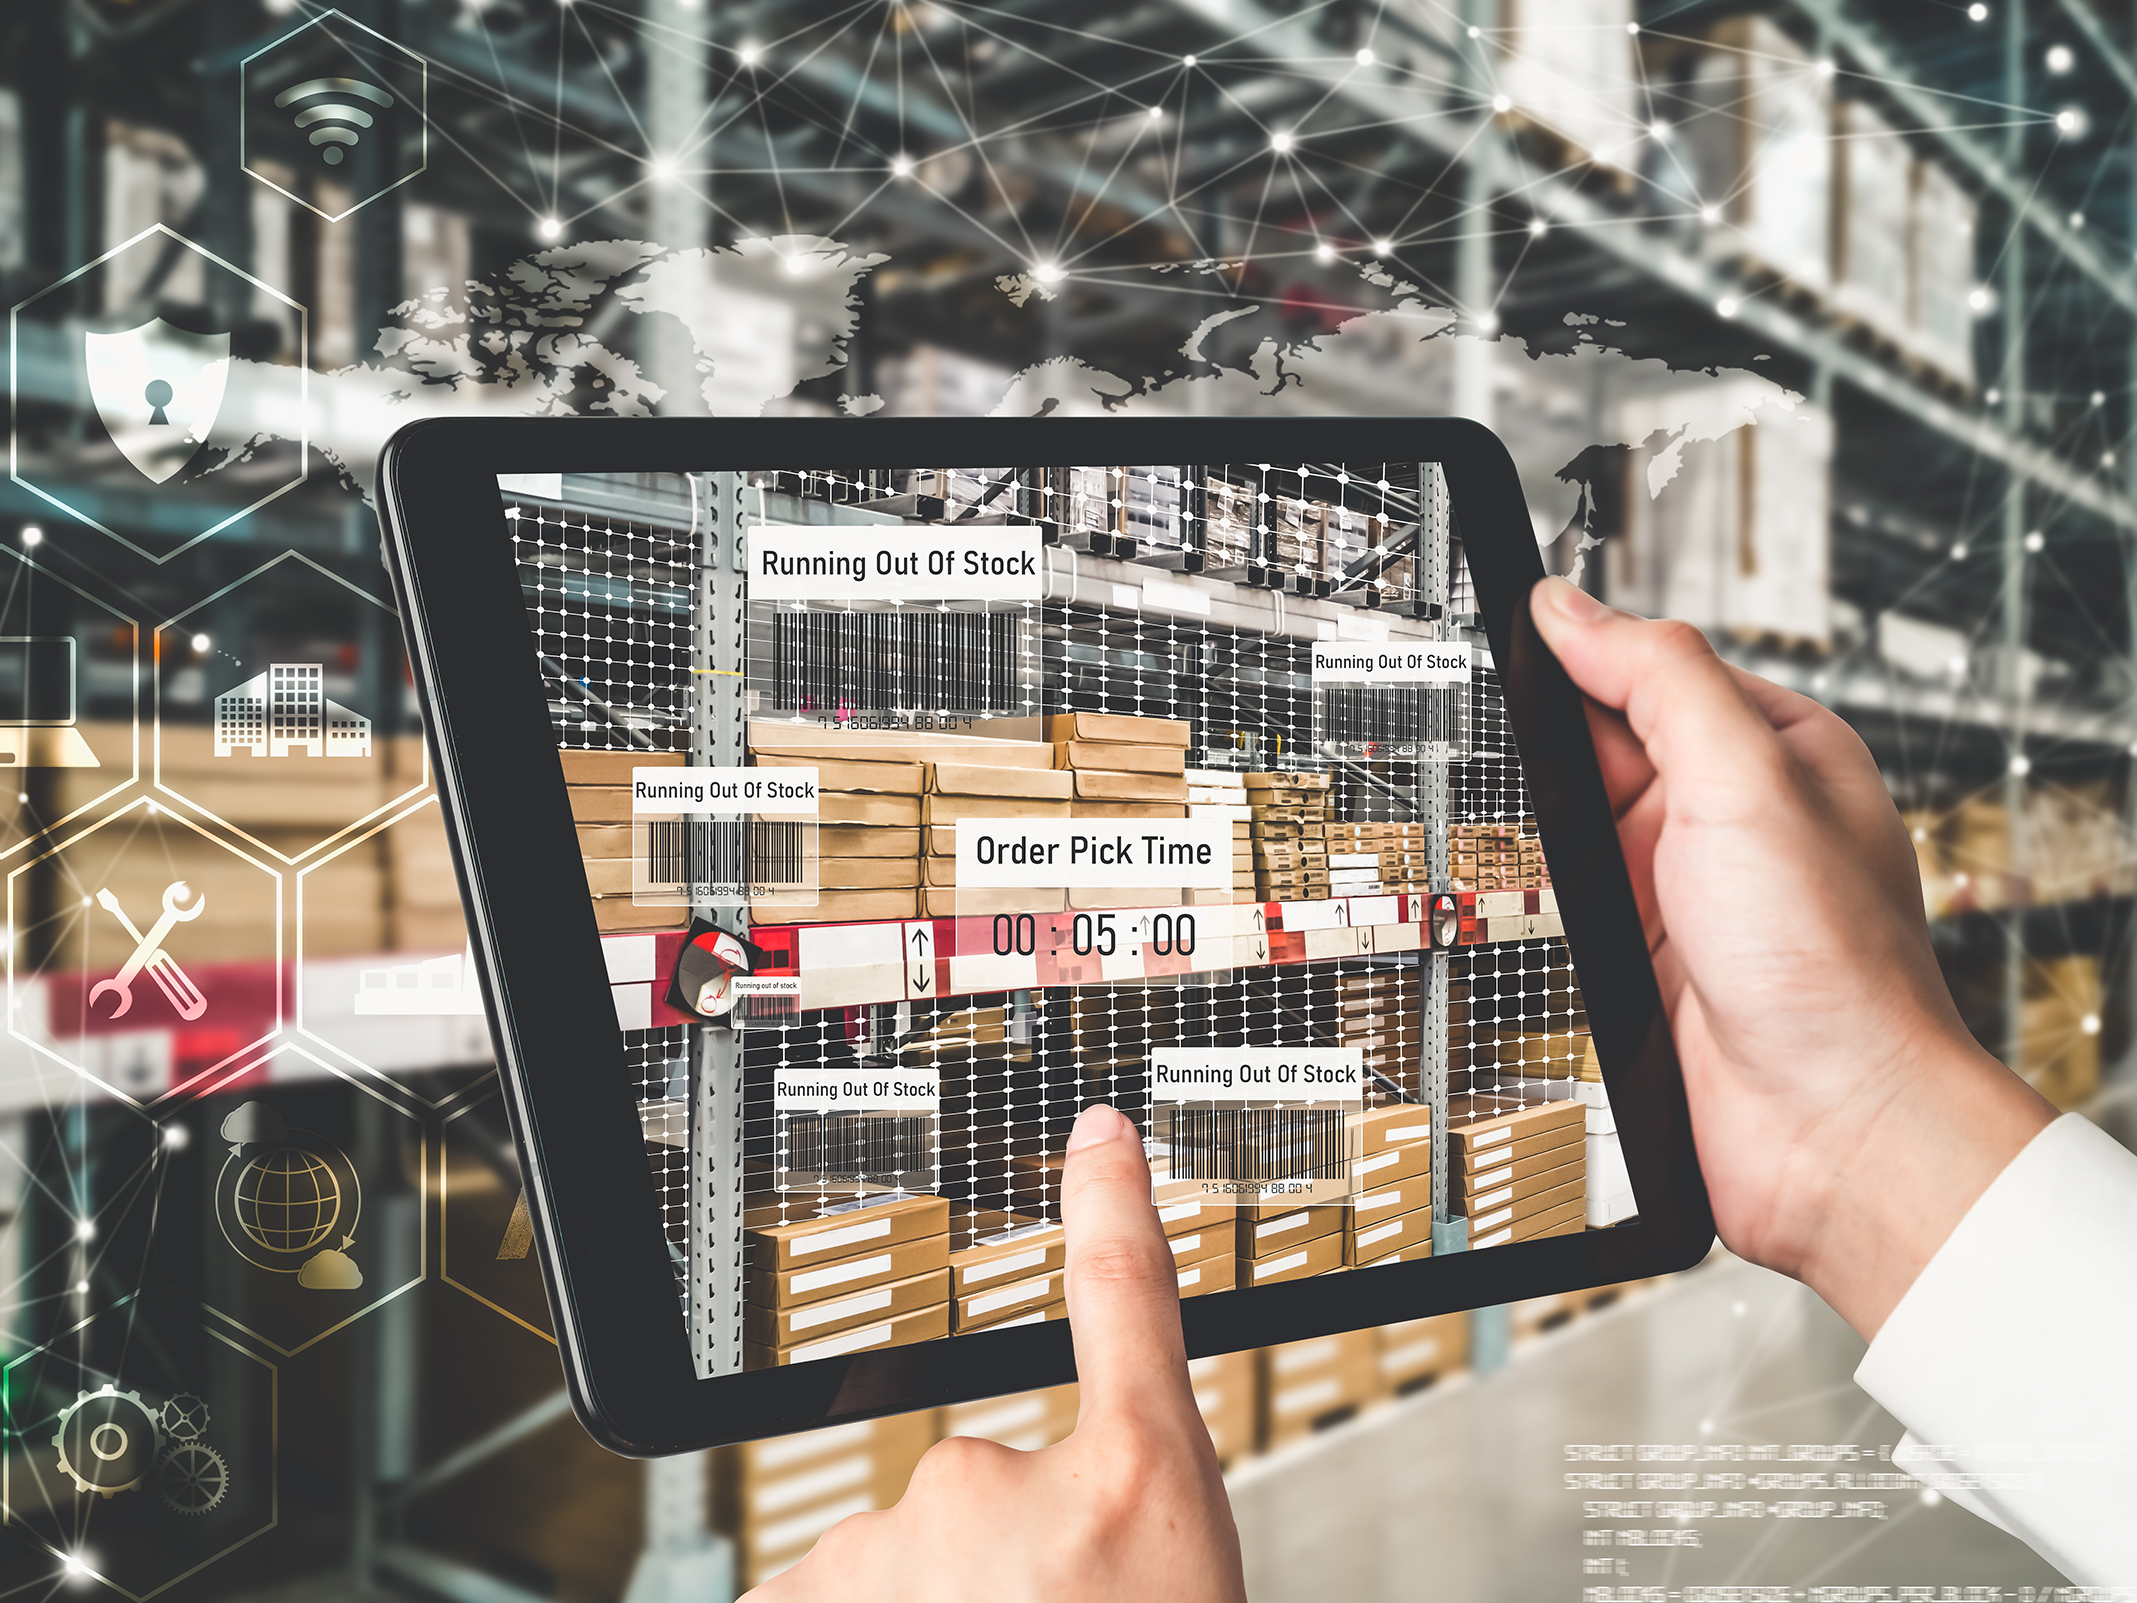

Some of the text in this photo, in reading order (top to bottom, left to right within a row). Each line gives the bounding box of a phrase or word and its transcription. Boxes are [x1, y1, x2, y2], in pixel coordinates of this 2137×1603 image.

[763, 550, 1036, 582] Running Out Of Stock
[1315, 654, 1467, 673] Running Out Of Stock
[832, 716, 842, 731] 5
[914, 716, 934, 731] 88
[938, 716, 958, 731] 00
[963, 716, 972, 731] 4
[636, 781, 815, 803] Running Out Of Stock
[977, 835, 1212, 865] Order Pick Time
[768, 886, 775, 896] 4
[993, 913, 1035, 956] 00
[1073, 913, 1116, 956] 05
[1153, 913, 1195, 956] 00
[735, 982, 760, 990] Running
[1156, 1064, 1357, 1088] Running Out Of Stock
[777, 1081, 936, 1101] Running Out Of Stock
[1212, 1183, 1219, 1194] 5
[1271, 1183, 1285, 1194] 88
[1288, 1183, 1302, 1194] 00
[1306, 1183, 1313, 1194] 4
